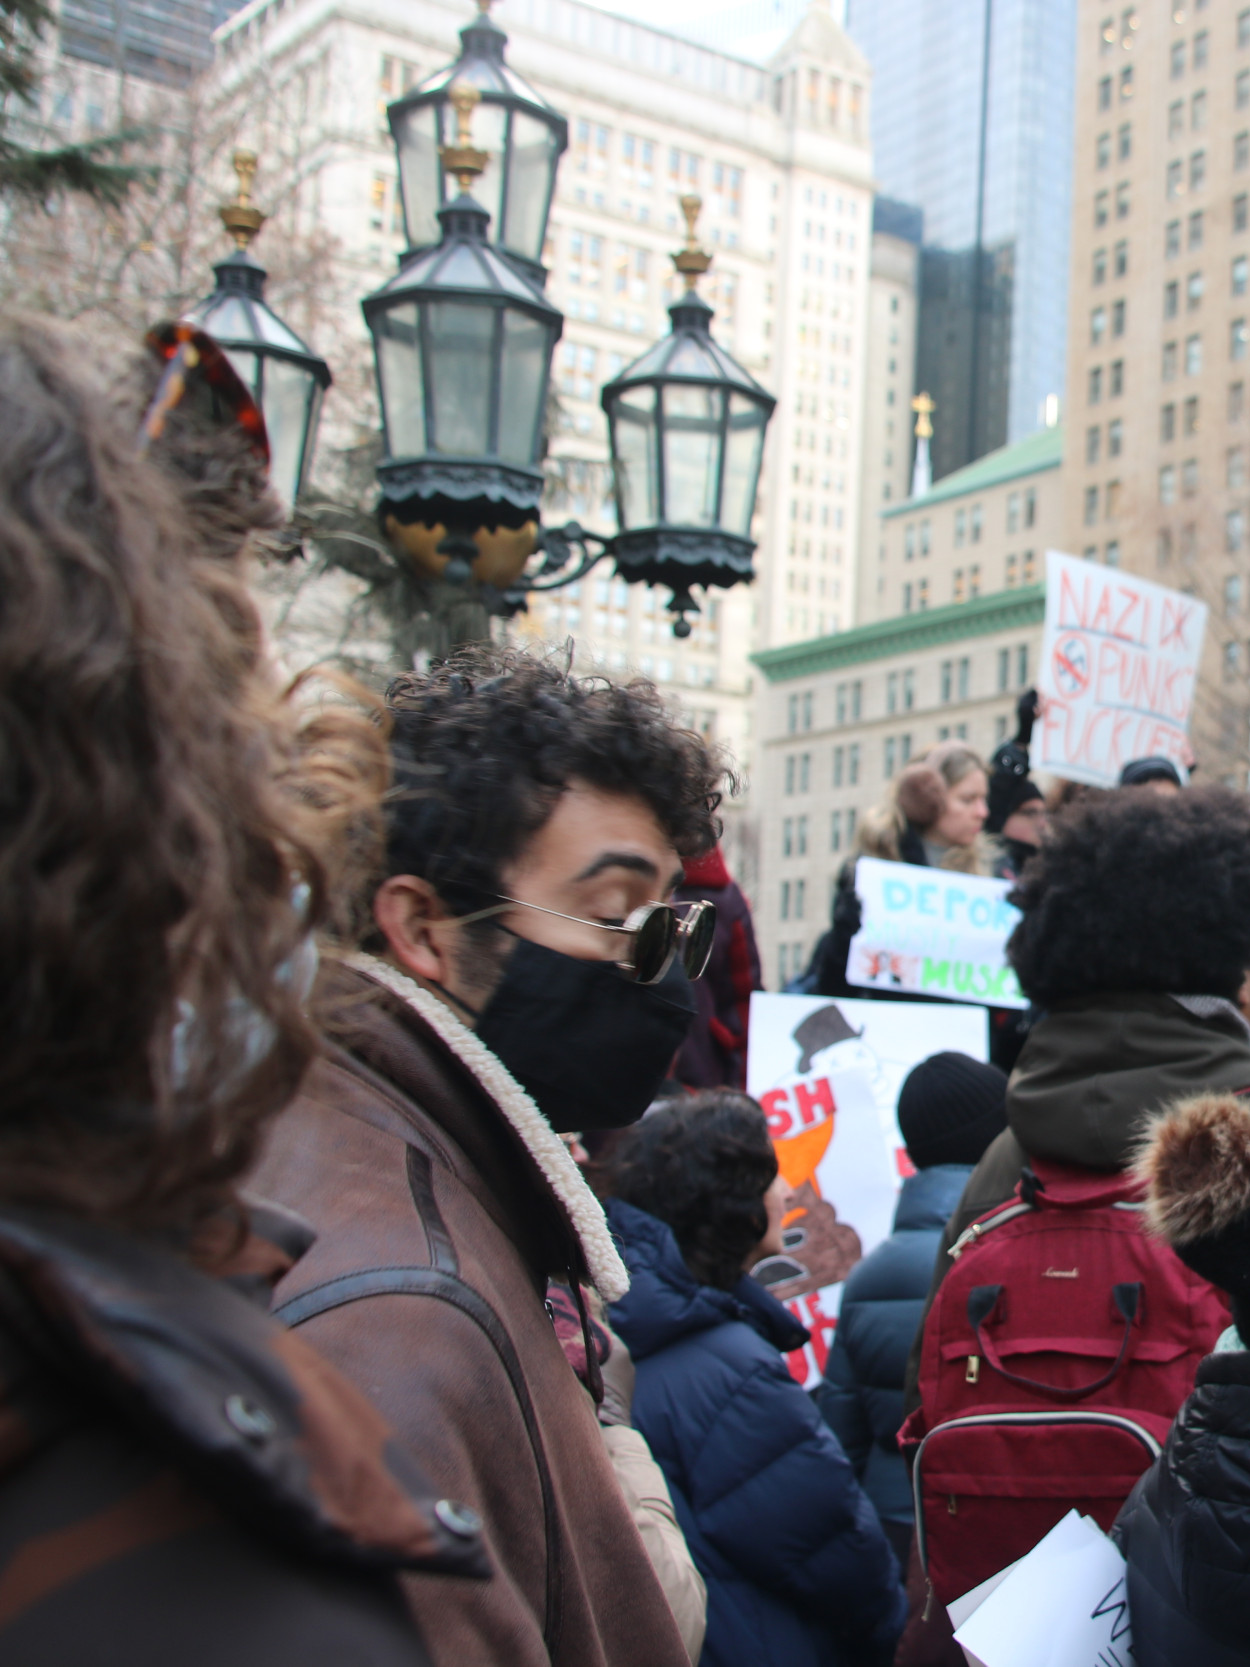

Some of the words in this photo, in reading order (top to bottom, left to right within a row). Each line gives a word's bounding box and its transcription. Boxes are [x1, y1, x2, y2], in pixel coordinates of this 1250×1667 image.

[1058, 567, 1152, 646] NAZI
[1094, 640, 1195, 721] PUNKS
[1040, 698, 1132, 770] FUCK
